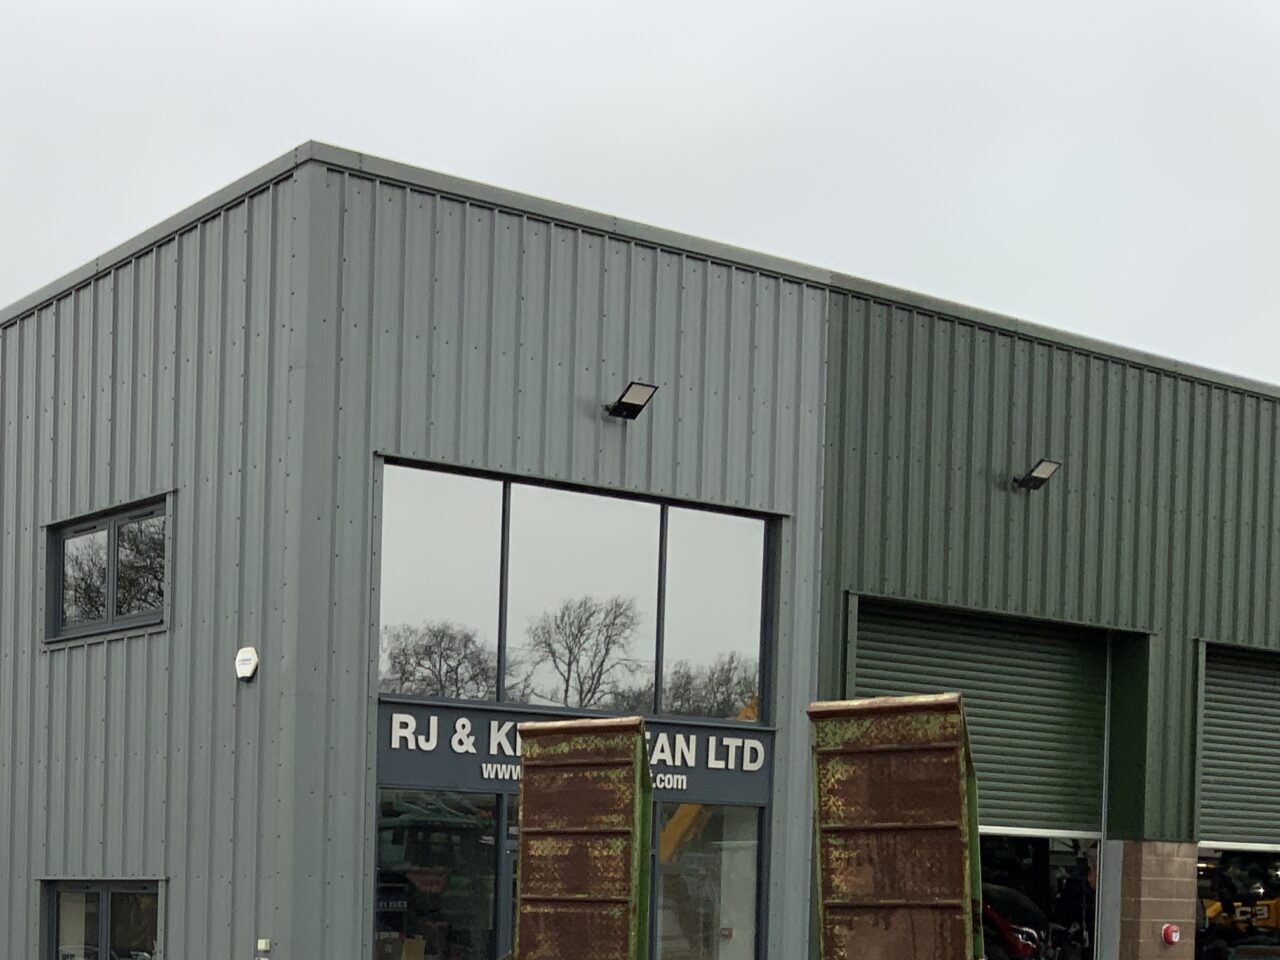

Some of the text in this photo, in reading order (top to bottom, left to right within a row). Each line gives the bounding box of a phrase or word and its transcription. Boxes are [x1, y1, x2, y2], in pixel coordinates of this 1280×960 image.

[391, 713, 438, 751] RJ
[451, 717, 477, 753] &
[707, 735, 765, 771] LTD
